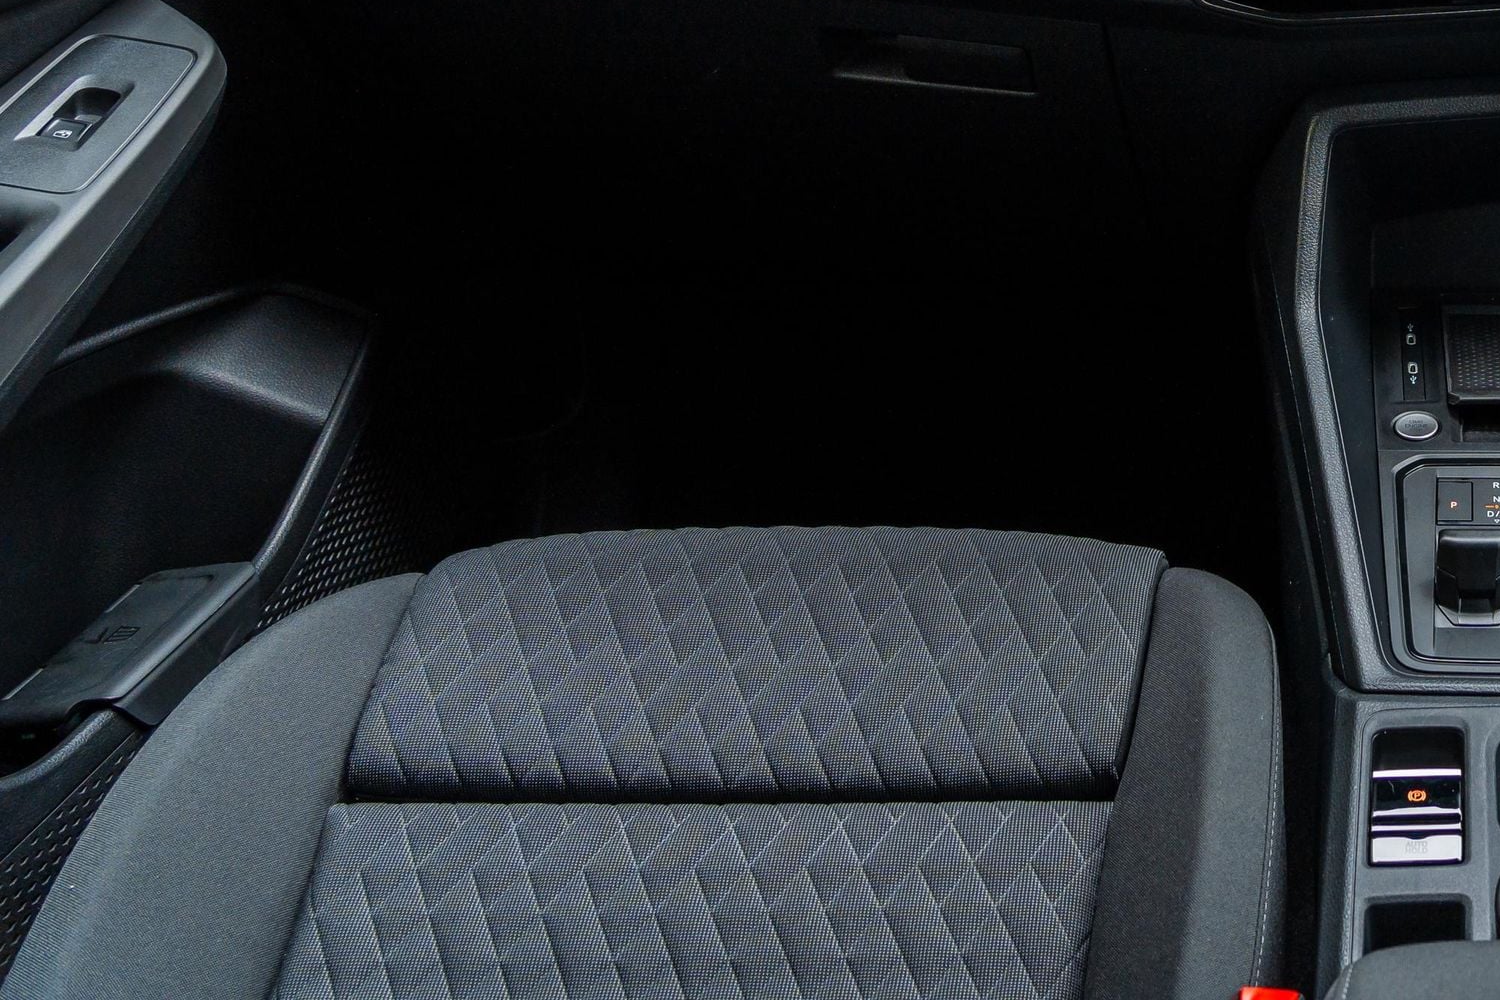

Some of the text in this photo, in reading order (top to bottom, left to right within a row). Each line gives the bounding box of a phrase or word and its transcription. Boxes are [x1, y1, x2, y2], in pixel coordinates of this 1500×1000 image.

[1492, 481, 1500, 489] R
[1493, 495, 1500, 503] N
[1450, 501, 1458, 509] P
